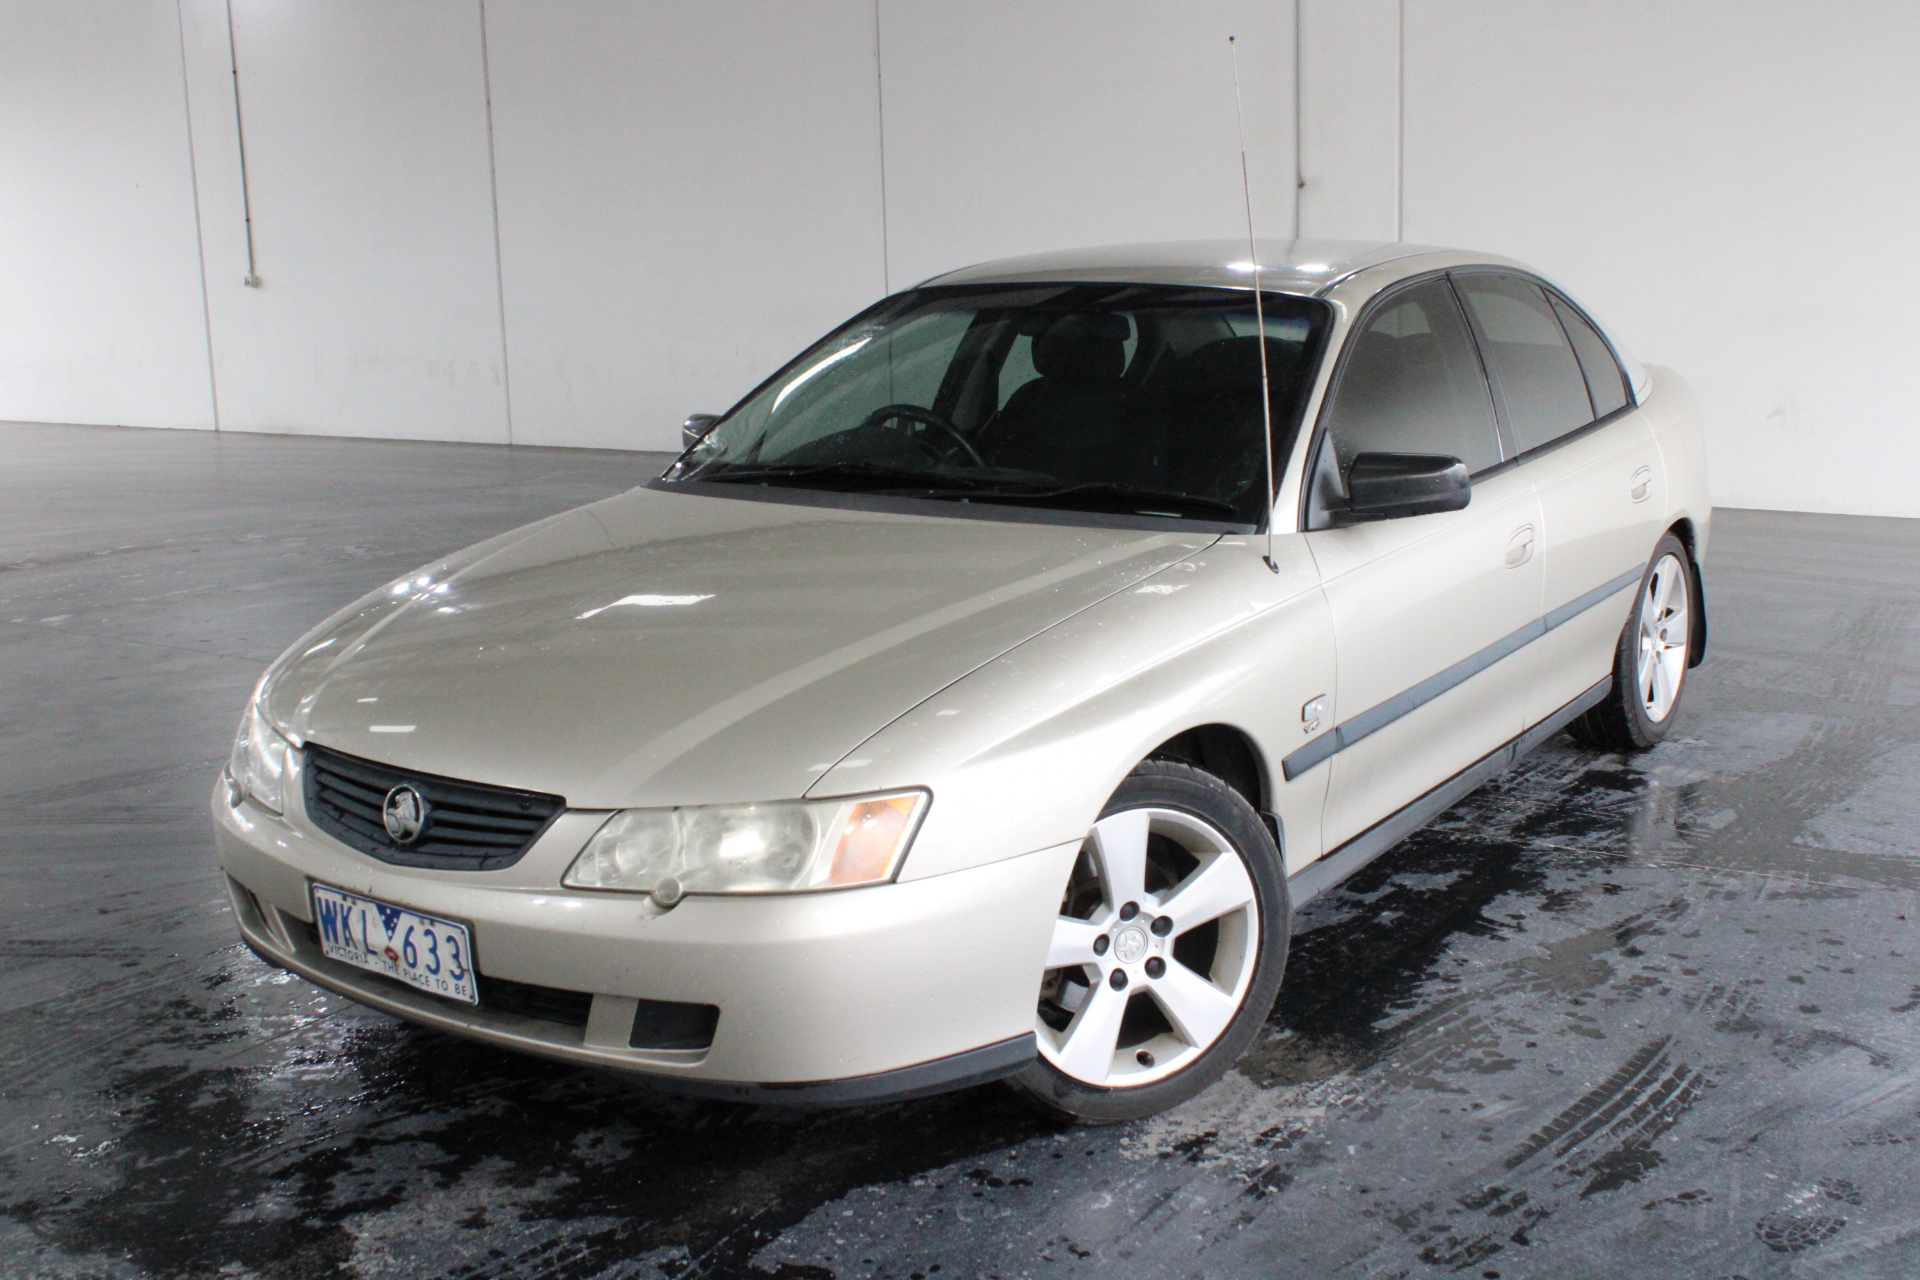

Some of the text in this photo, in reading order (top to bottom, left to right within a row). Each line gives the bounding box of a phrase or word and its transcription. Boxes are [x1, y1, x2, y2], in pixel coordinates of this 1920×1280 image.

[317, 896, 465, 981] WKL 633
[328, 944, 370, 966] VICTORIA
[382, 961, 399, 975] THE
[403, 969, 430, 987] PLACE
[436, 978, 448, 991] TO
[454, 983, 467, 996] BE
